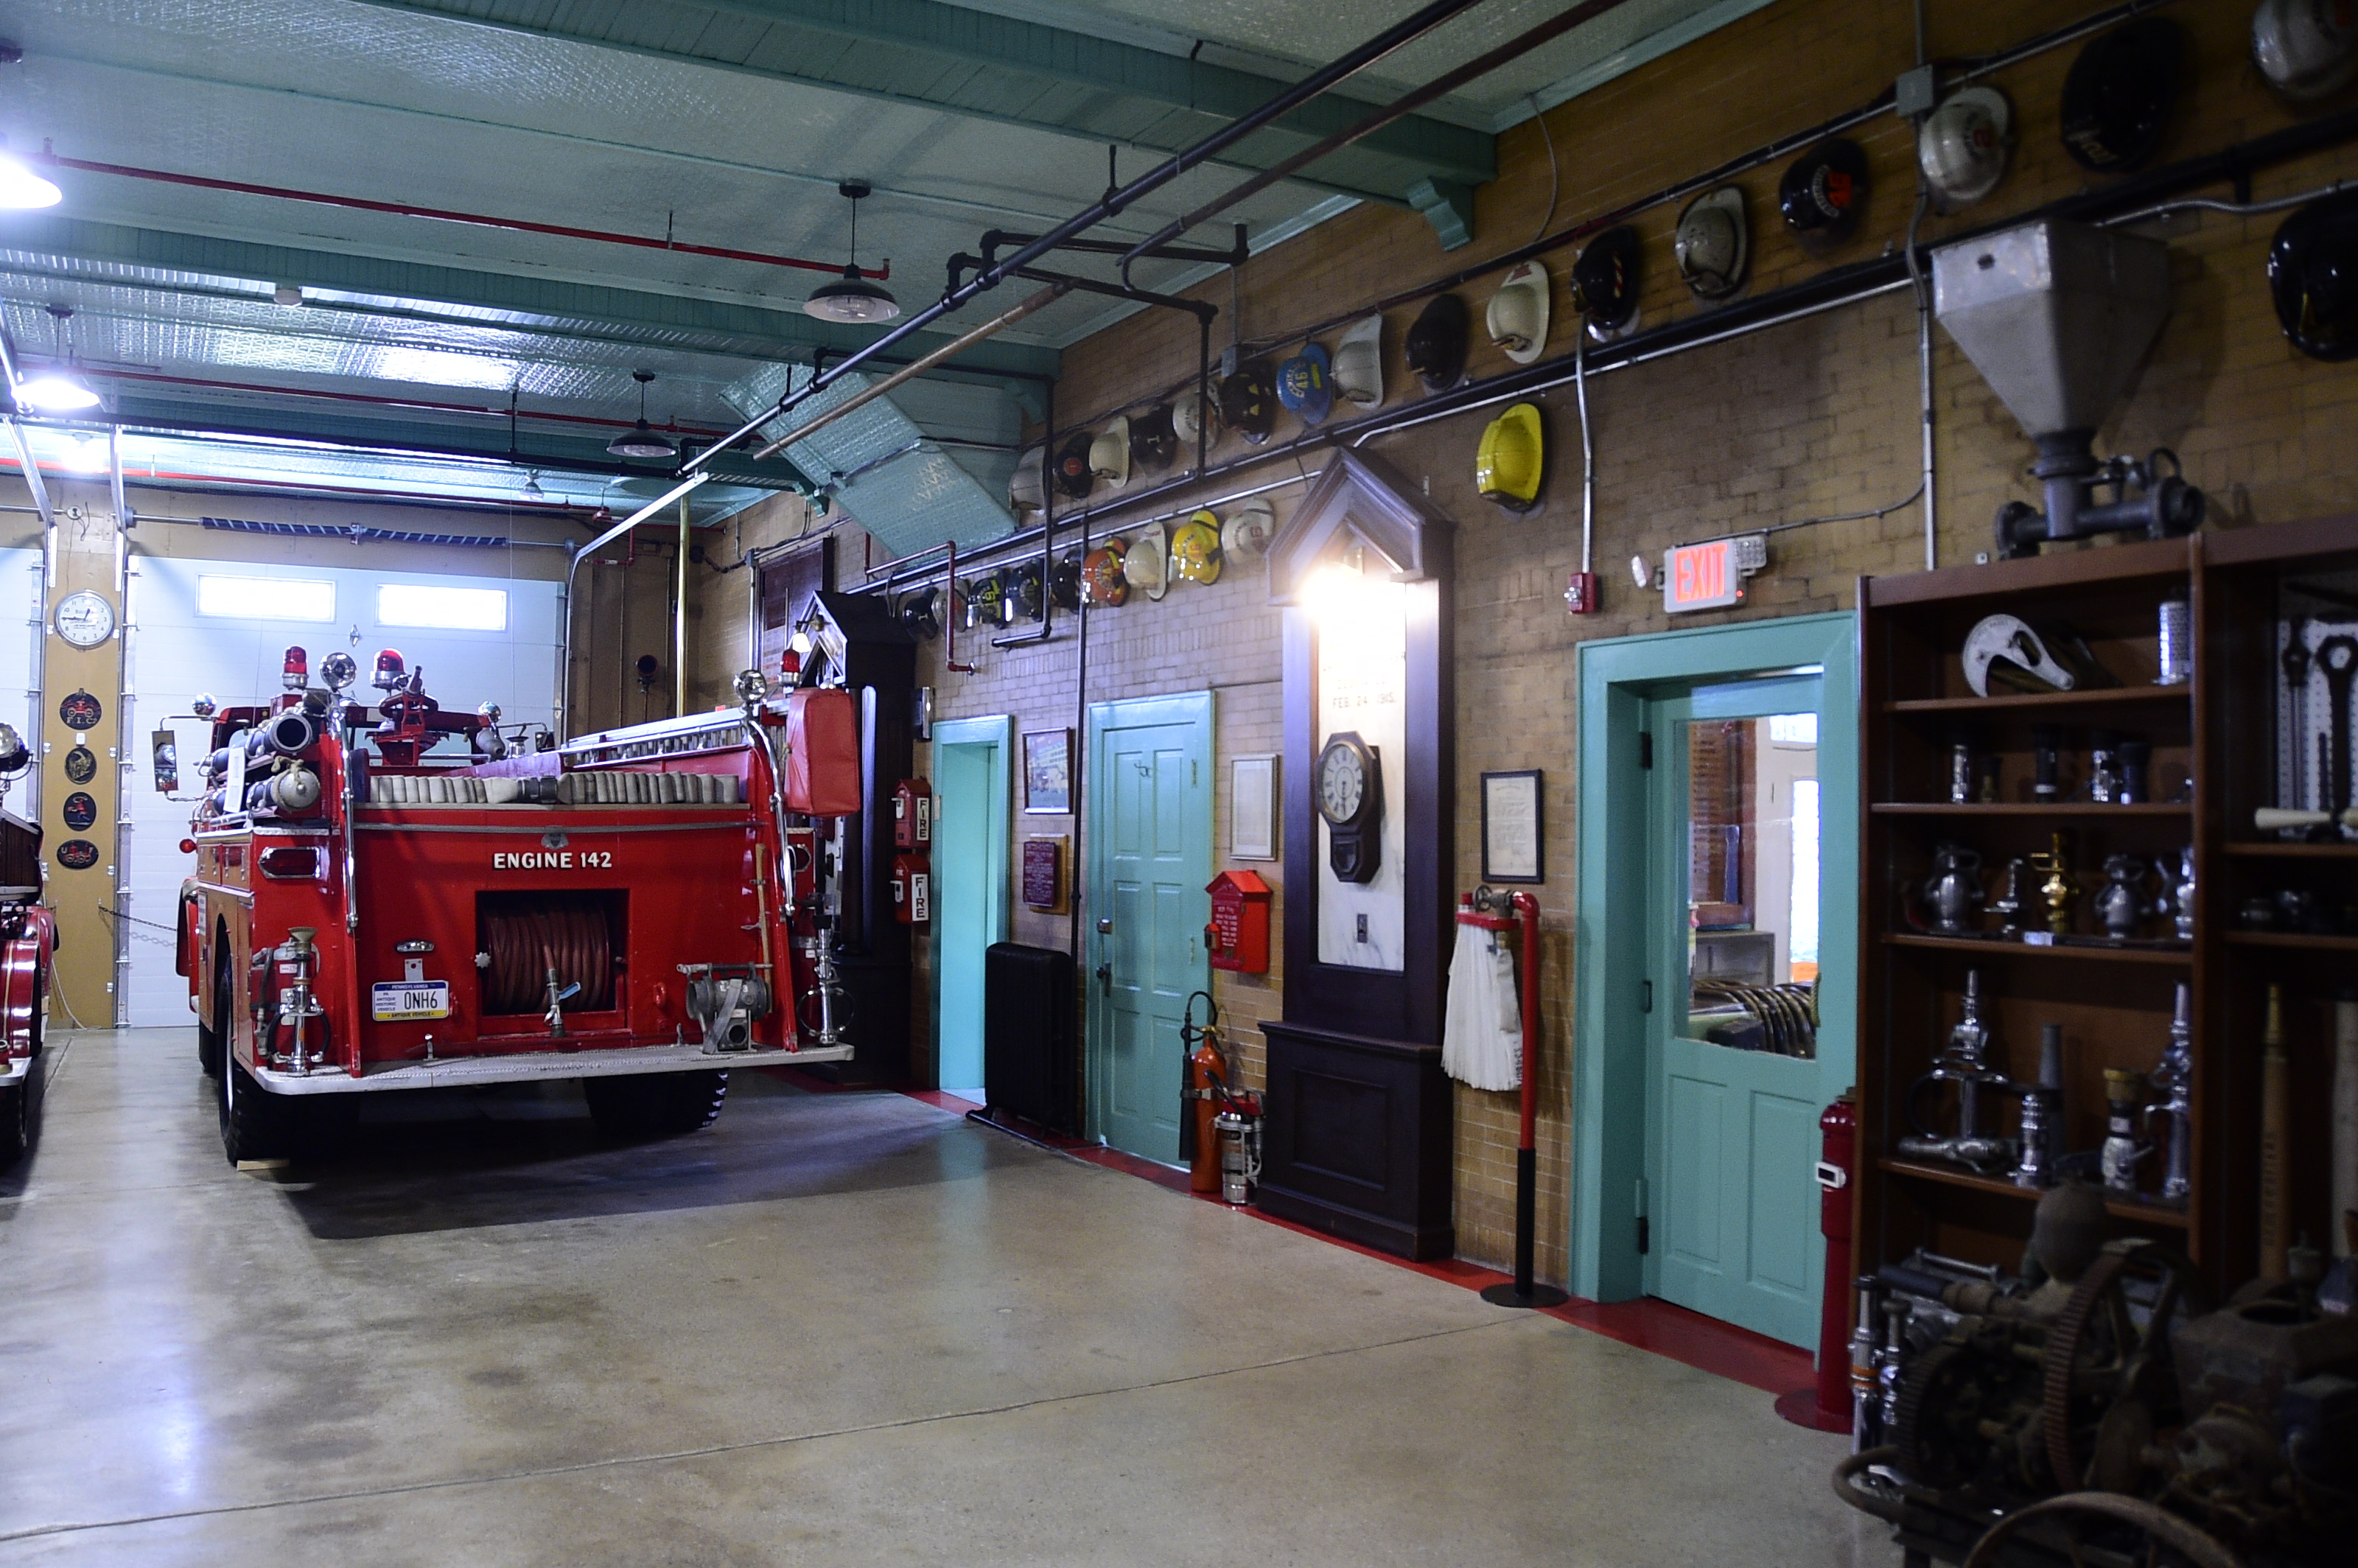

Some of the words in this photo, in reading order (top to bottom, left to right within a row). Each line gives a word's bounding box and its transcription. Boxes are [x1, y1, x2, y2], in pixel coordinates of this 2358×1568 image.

[1675, 542, 1728, 603] EXIT
[919, 799, 928, 838] FIRE
[494, 852, 573, 869] ENGINE
[580, 851, 613, 869] 142
[915, 877, 925, 919] FIRE
